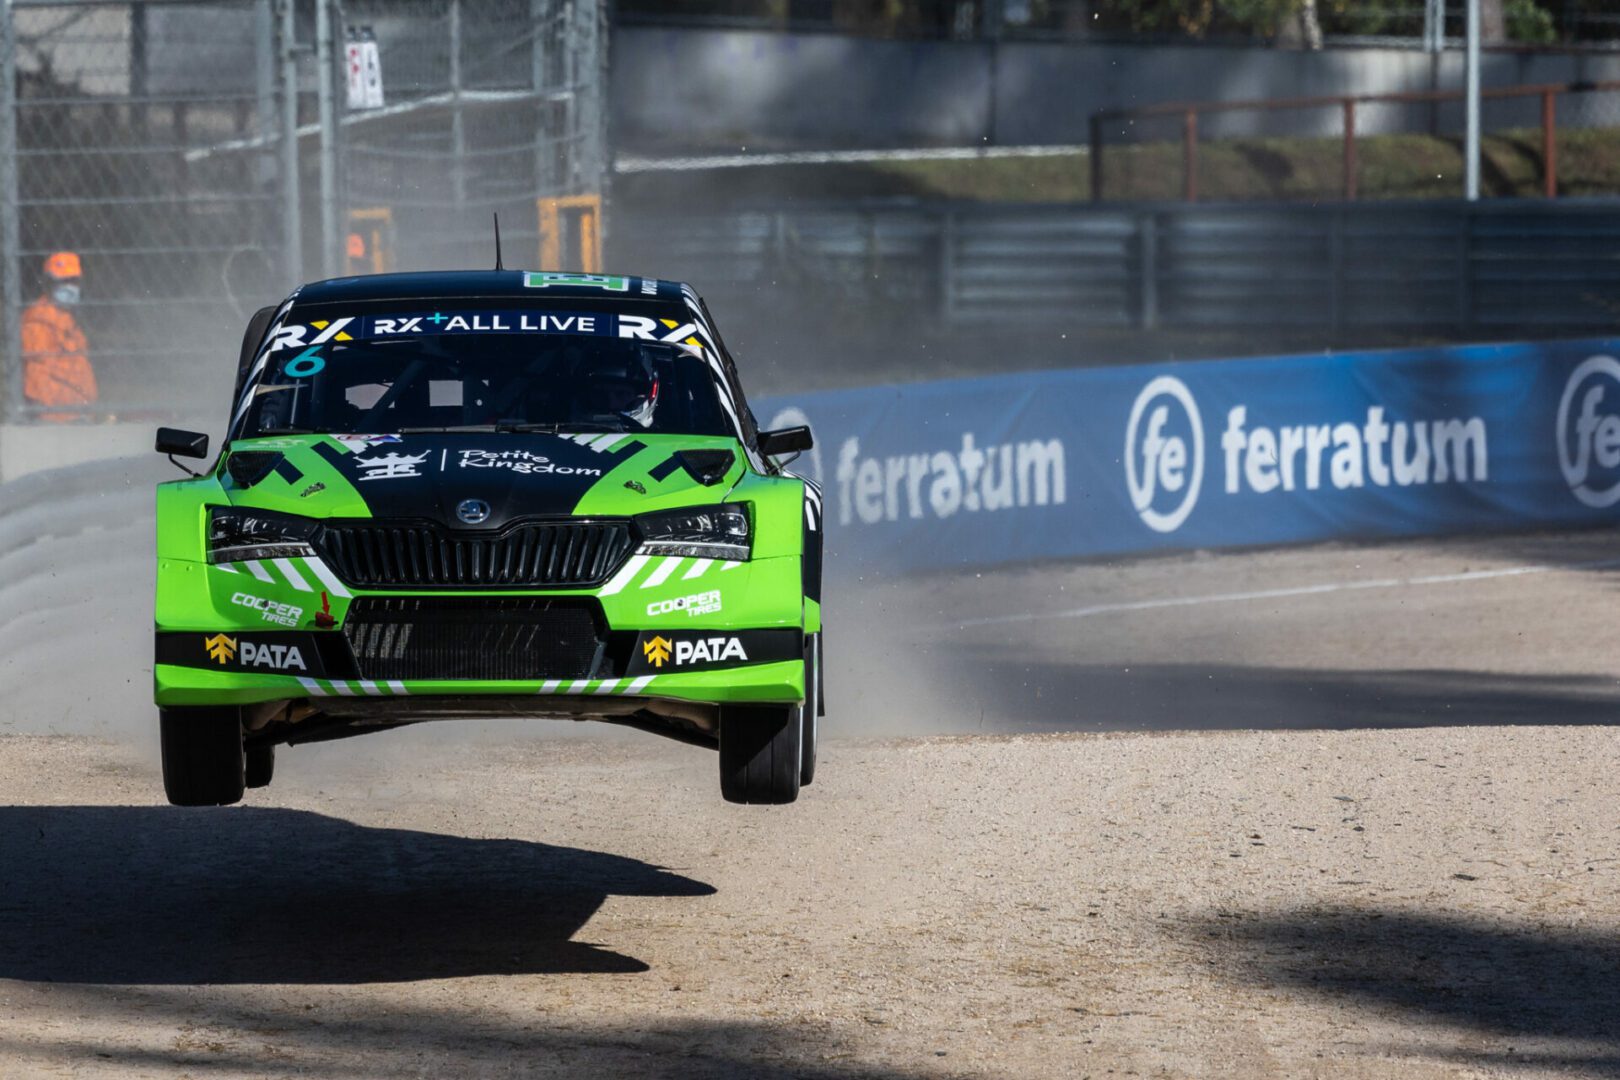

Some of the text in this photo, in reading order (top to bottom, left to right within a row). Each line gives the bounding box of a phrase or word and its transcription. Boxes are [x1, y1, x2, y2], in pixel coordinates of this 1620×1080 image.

[271, 316, 356, 352] RX
[520, 315, 595, 332] LIVE
[618, 314, 704, 349] RX
[284, 345, 326, 377] 6
[458, 449, 549, 463] Petite
[1221, 405, 1488, 494] ferratum
[458, 458, 601, 476] Kingdom
[836, 432, 1067, 526] ferratum
[231, 591, 303, 619] COOPER
[646, 589, 721, 617] COOPER
[686, 604, 722, 617] TIRES
[261, 611, 299, 628] TIRES
[240, 641, 307, 671] PATA
[675, 637, 748, 666] PATA
